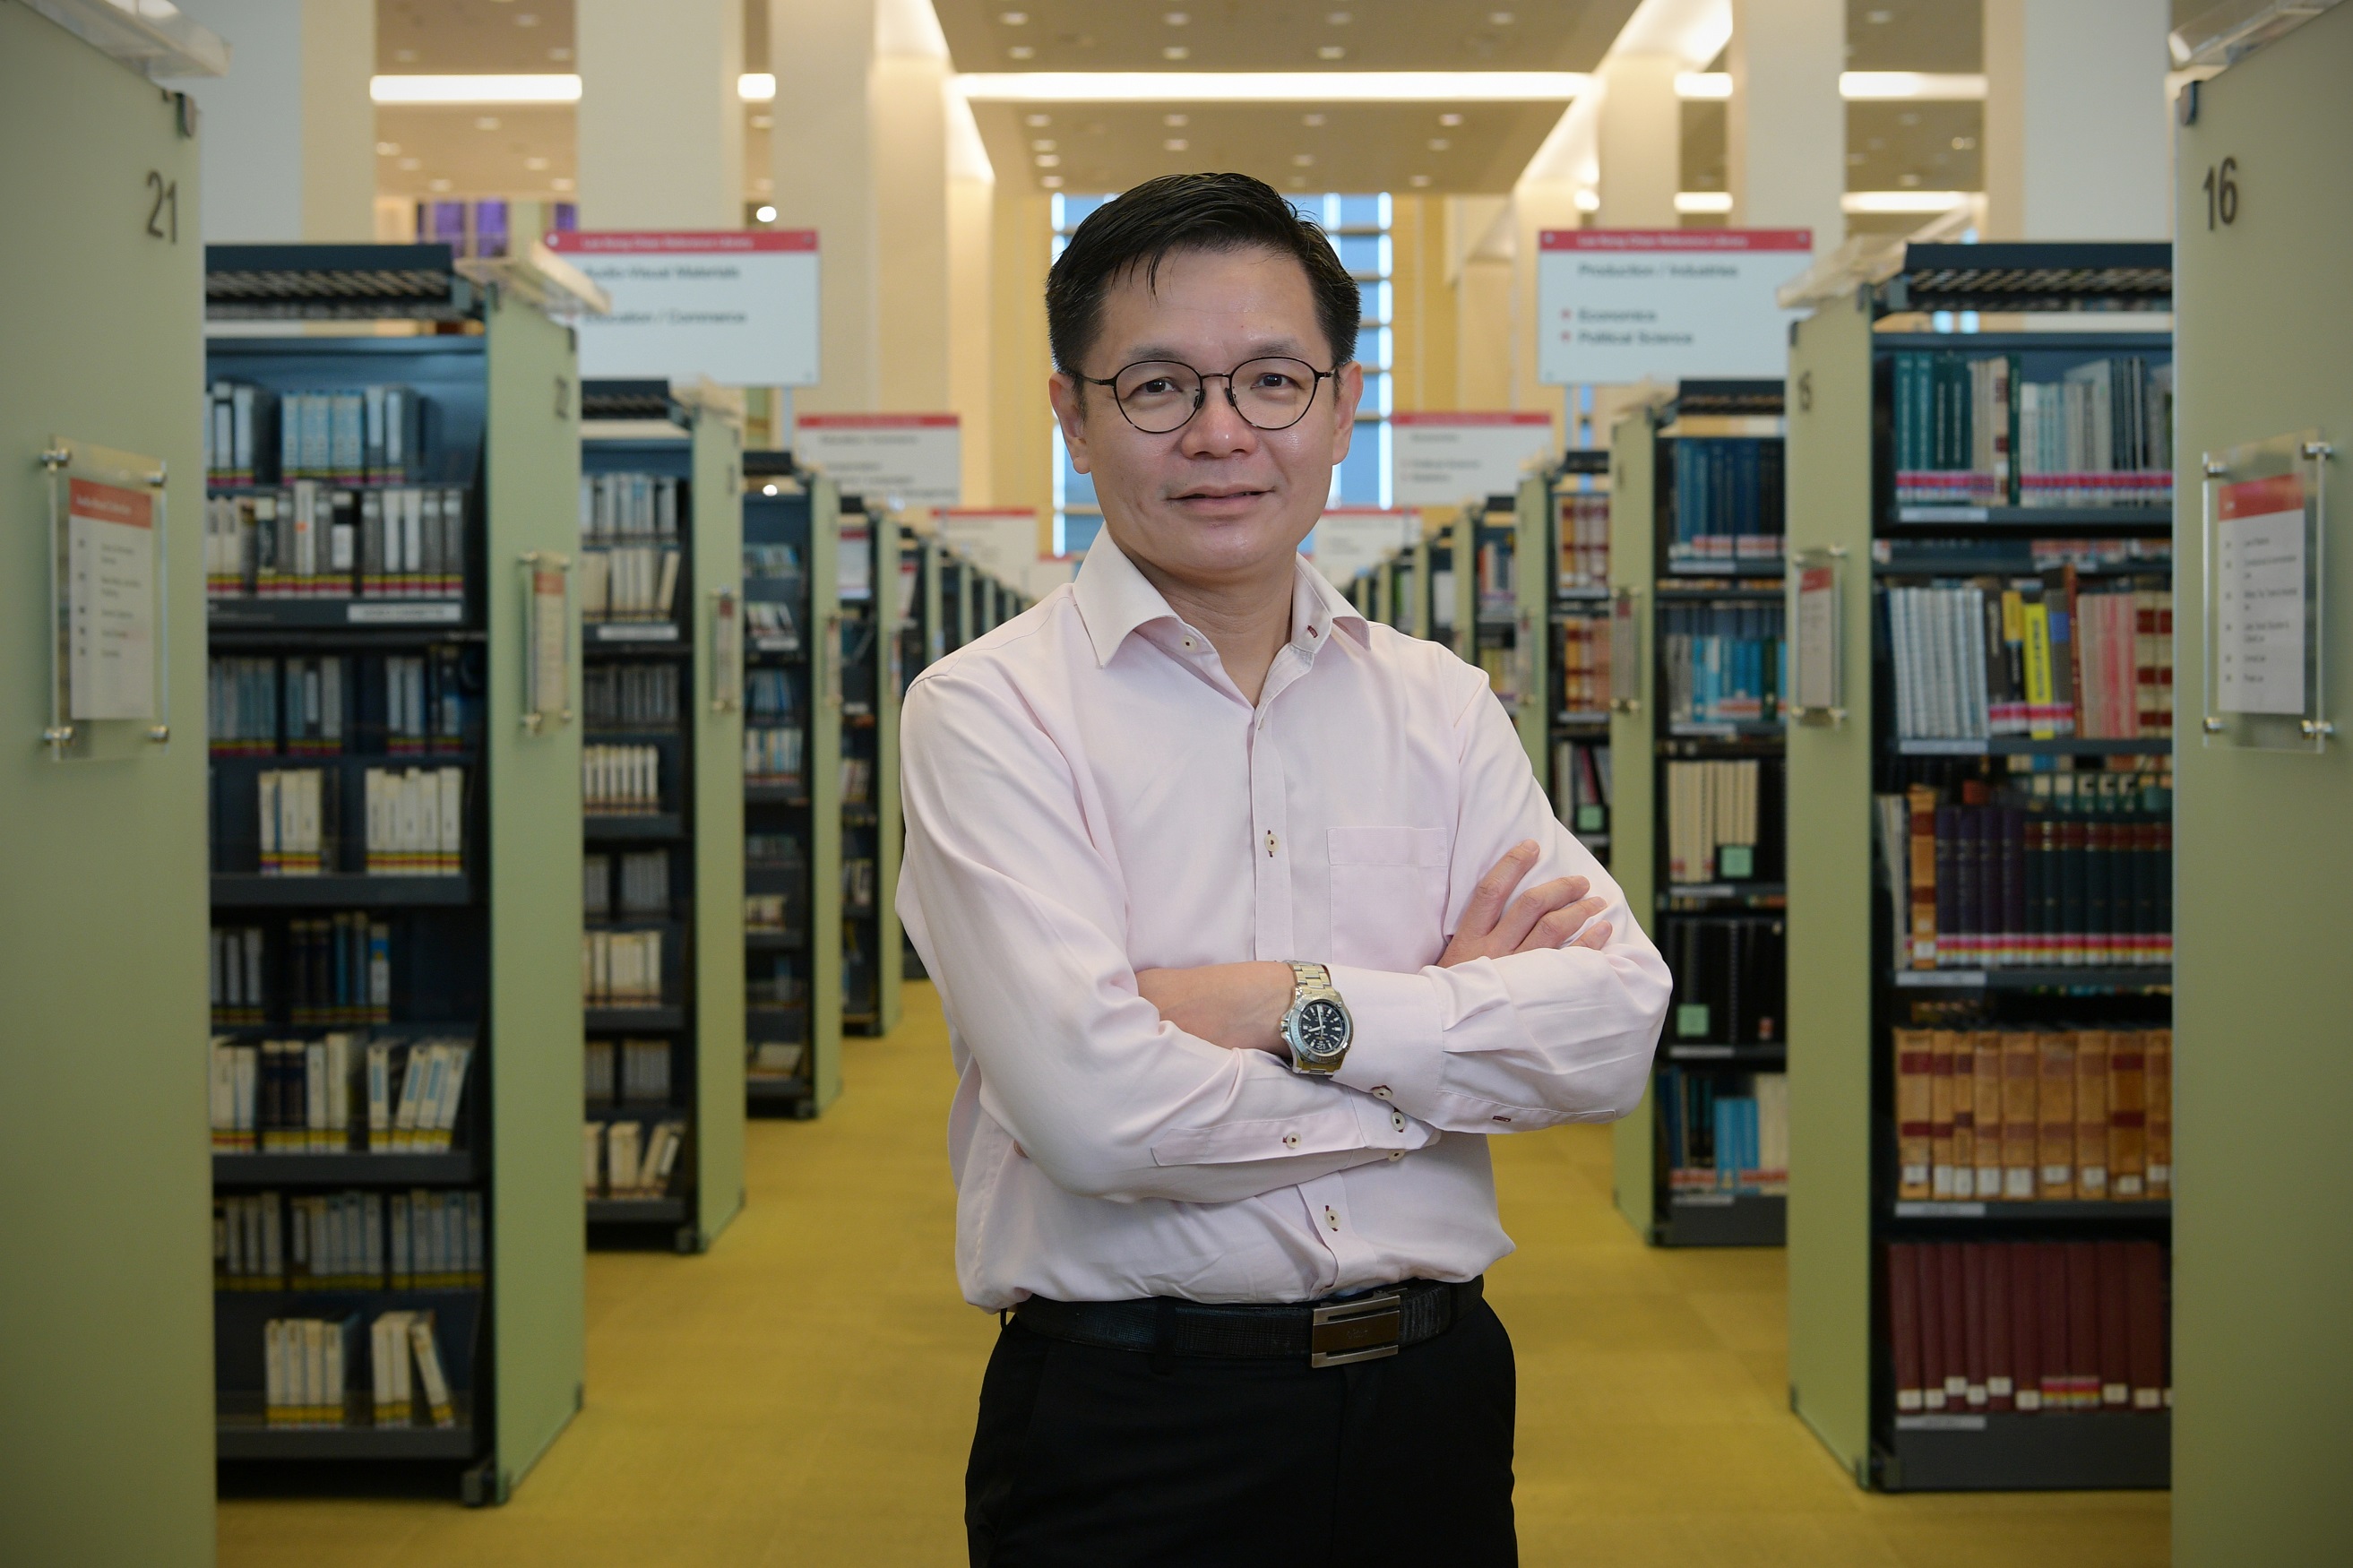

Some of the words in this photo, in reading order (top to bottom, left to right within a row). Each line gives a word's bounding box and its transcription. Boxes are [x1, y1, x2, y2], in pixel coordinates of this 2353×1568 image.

[2202, 156, 2238, 232] 16
[145, 169, 178, 245] 21
[1577, 263, 1655, 277] Production
[1669, 263, 1738, 277] Industries
[1577, 308, 1657, 322] Economics
[1577, 331, 1631, 345] Political
[1637, 331, 1694, 345] Science
